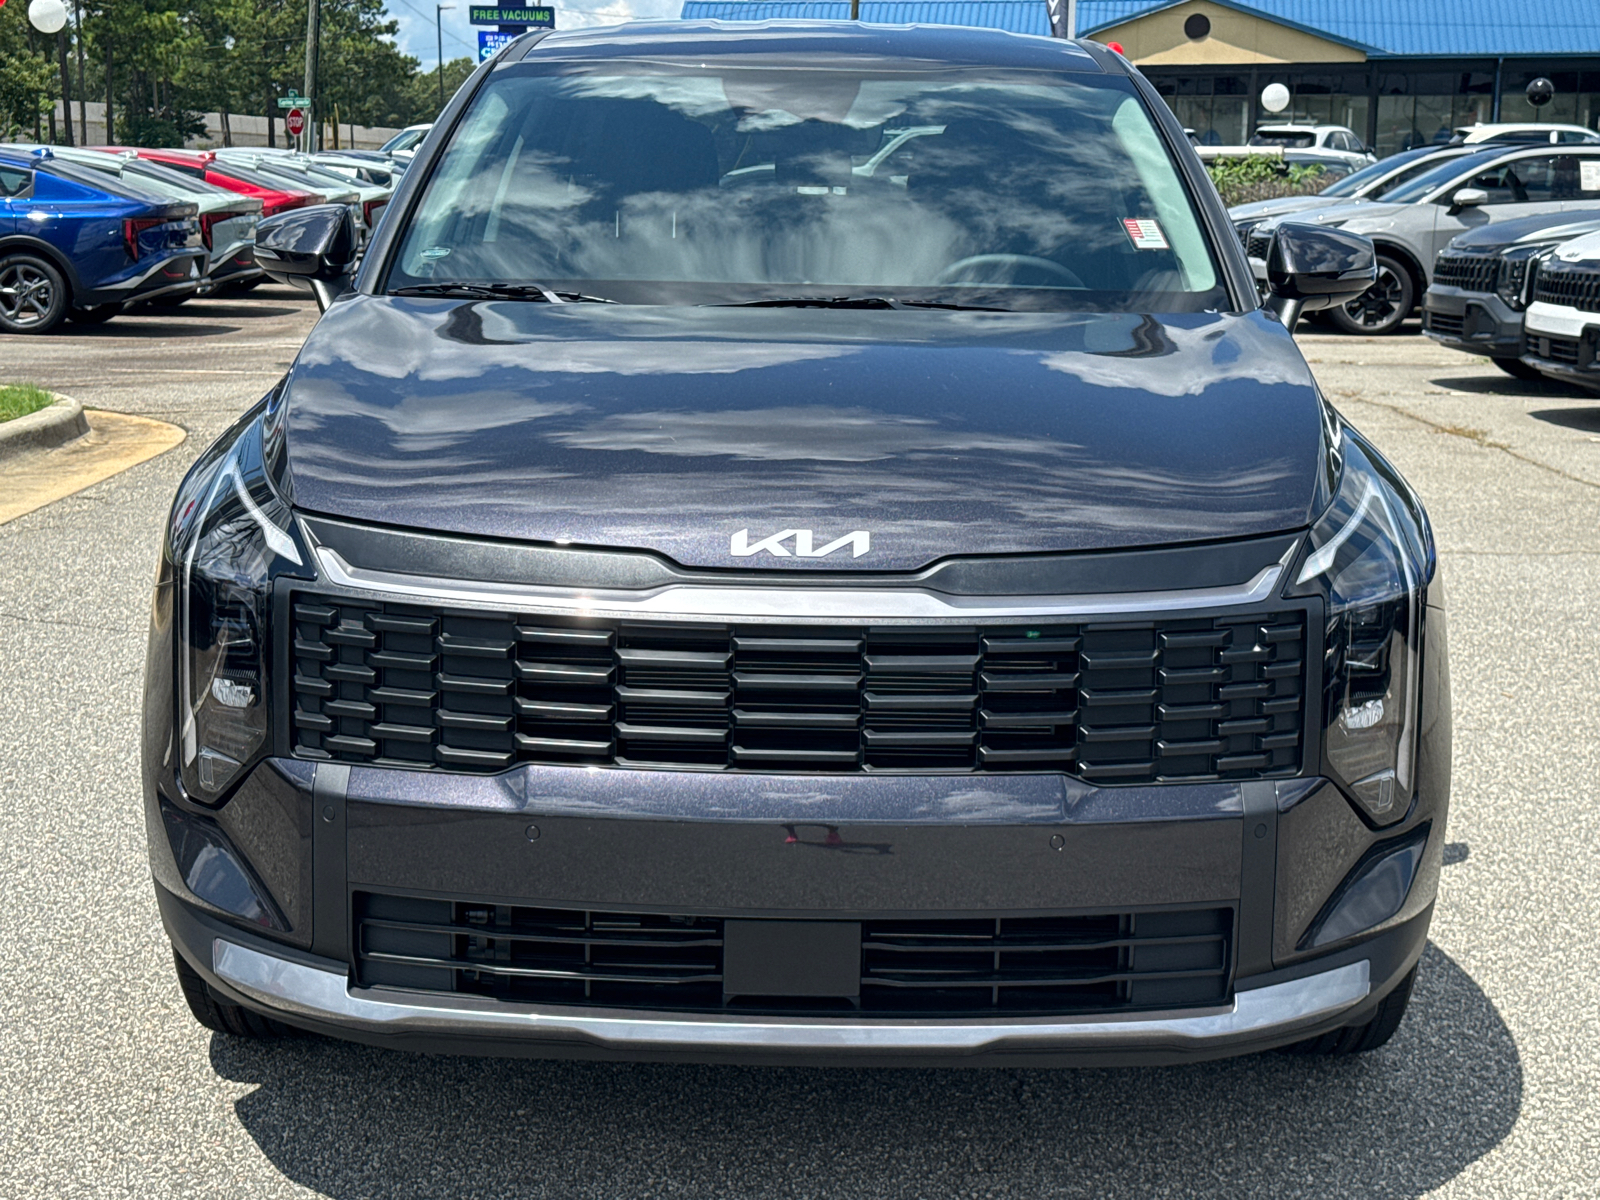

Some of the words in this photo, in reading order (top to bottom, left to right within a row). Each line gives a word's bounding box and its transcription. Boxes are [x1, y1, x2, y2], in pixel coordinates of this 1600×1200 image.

[473, 9, 500, 20] FREE
[502, 10, 550, 22] VACUUMS
[288, 117, 304, 128] STOP
[730, 528, 870, 559] KIA
